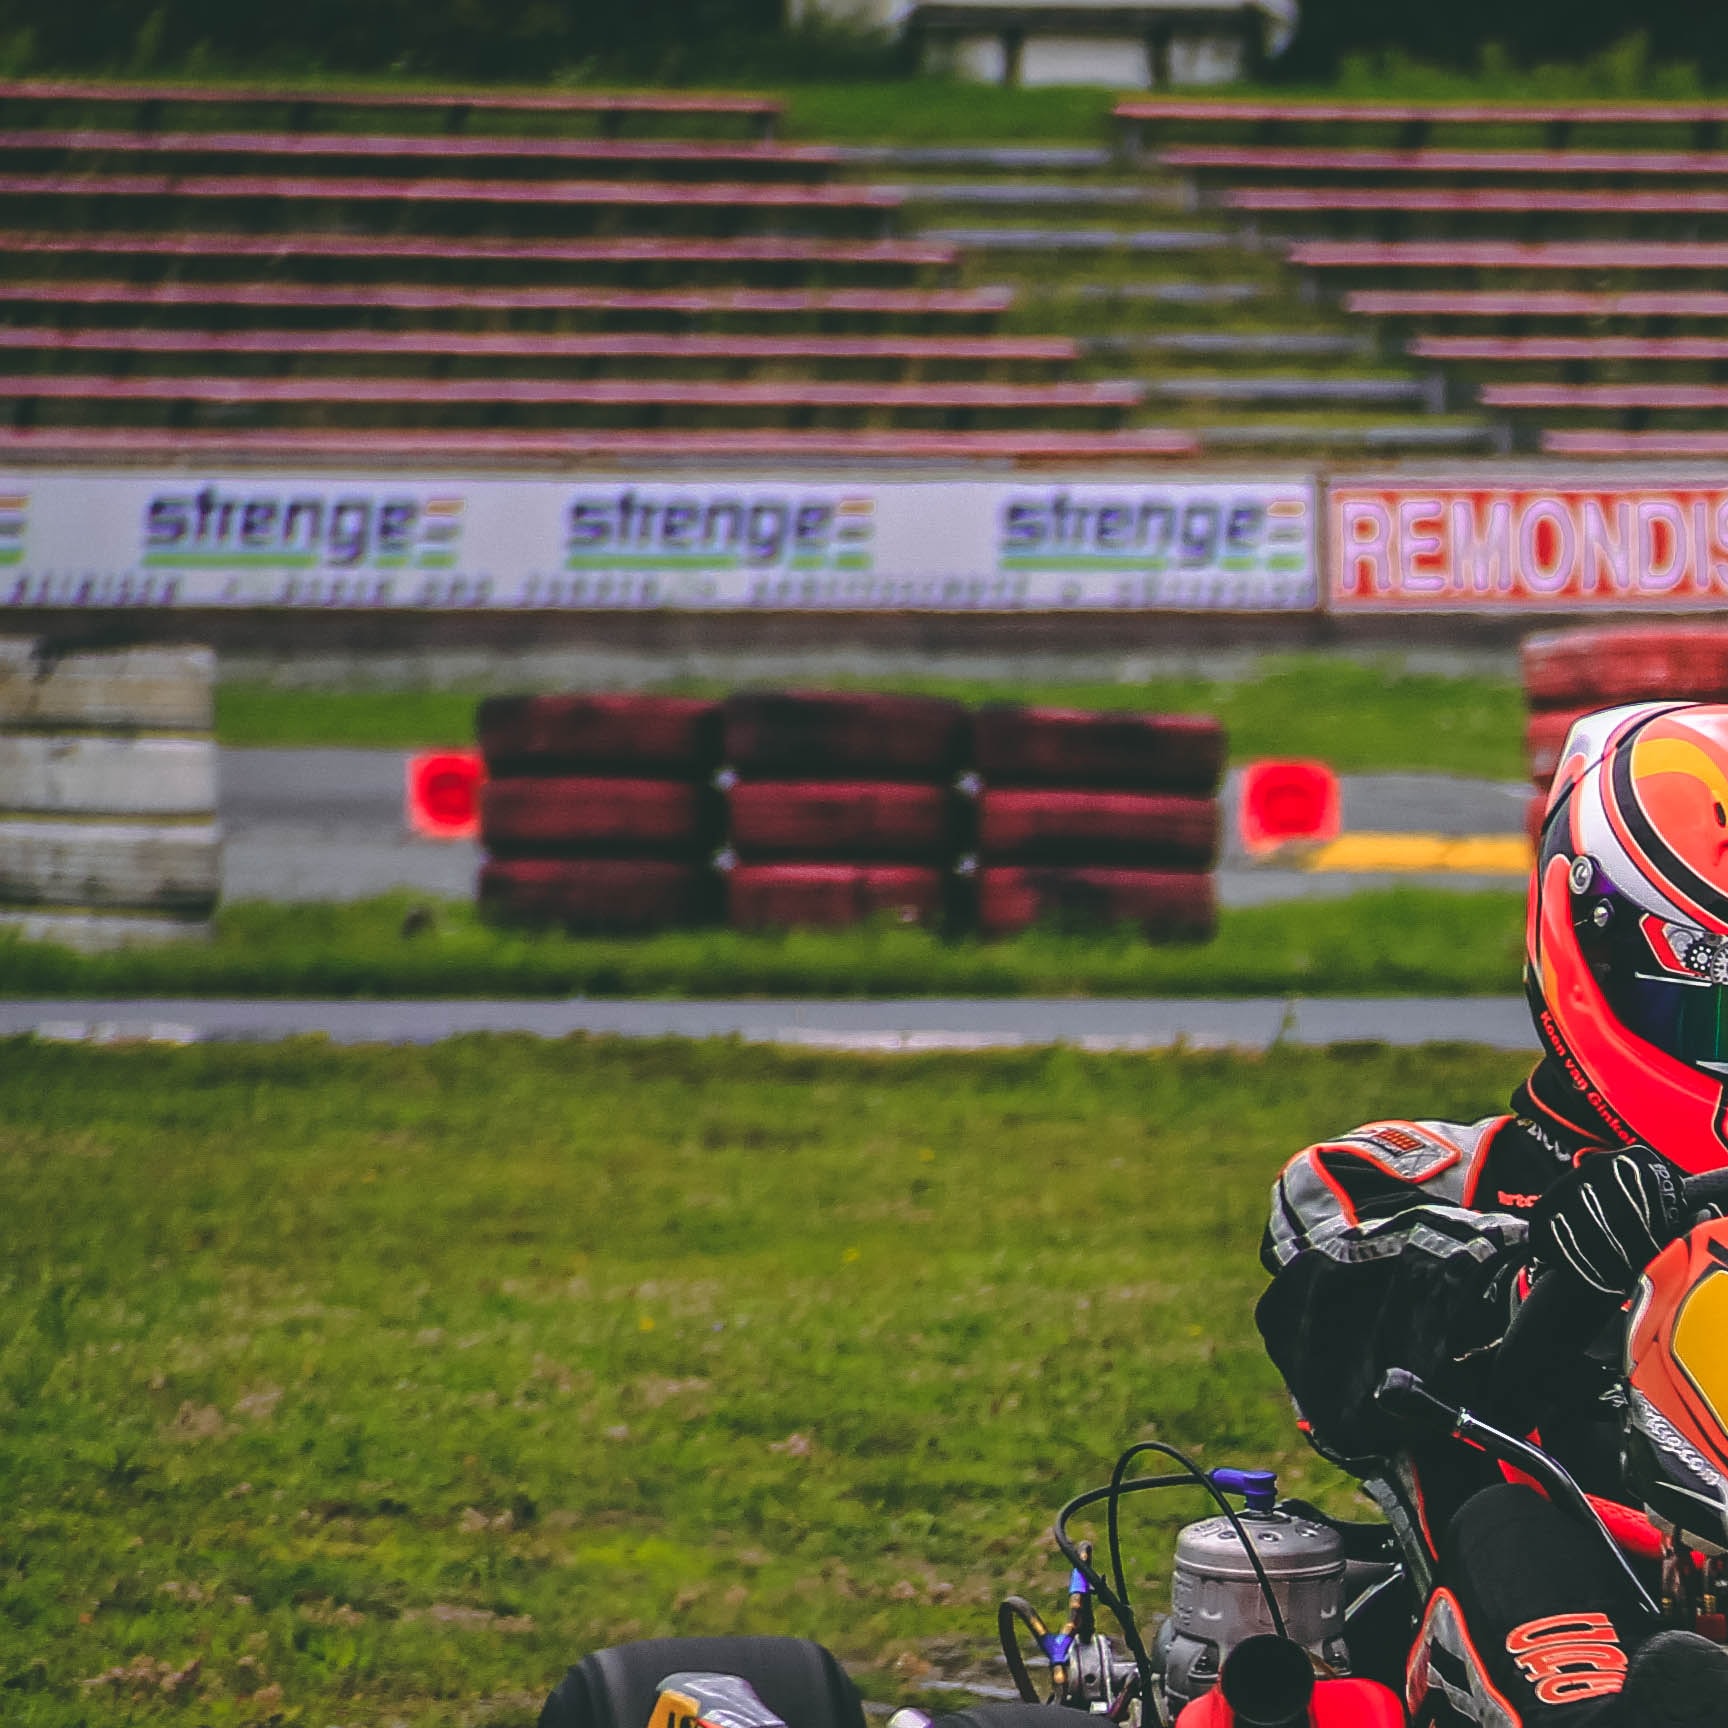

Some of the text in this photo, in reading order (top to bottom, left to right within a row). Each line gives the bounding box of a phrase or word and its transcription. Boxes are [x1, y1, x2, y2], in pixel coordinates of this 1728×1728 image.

[145, 488, 420, 568] strenge
[568, 489, 836, 568] strenge
[1000, 488, 1265, 568] strenge
[1506, 1612, 1629, 1705] CRG
